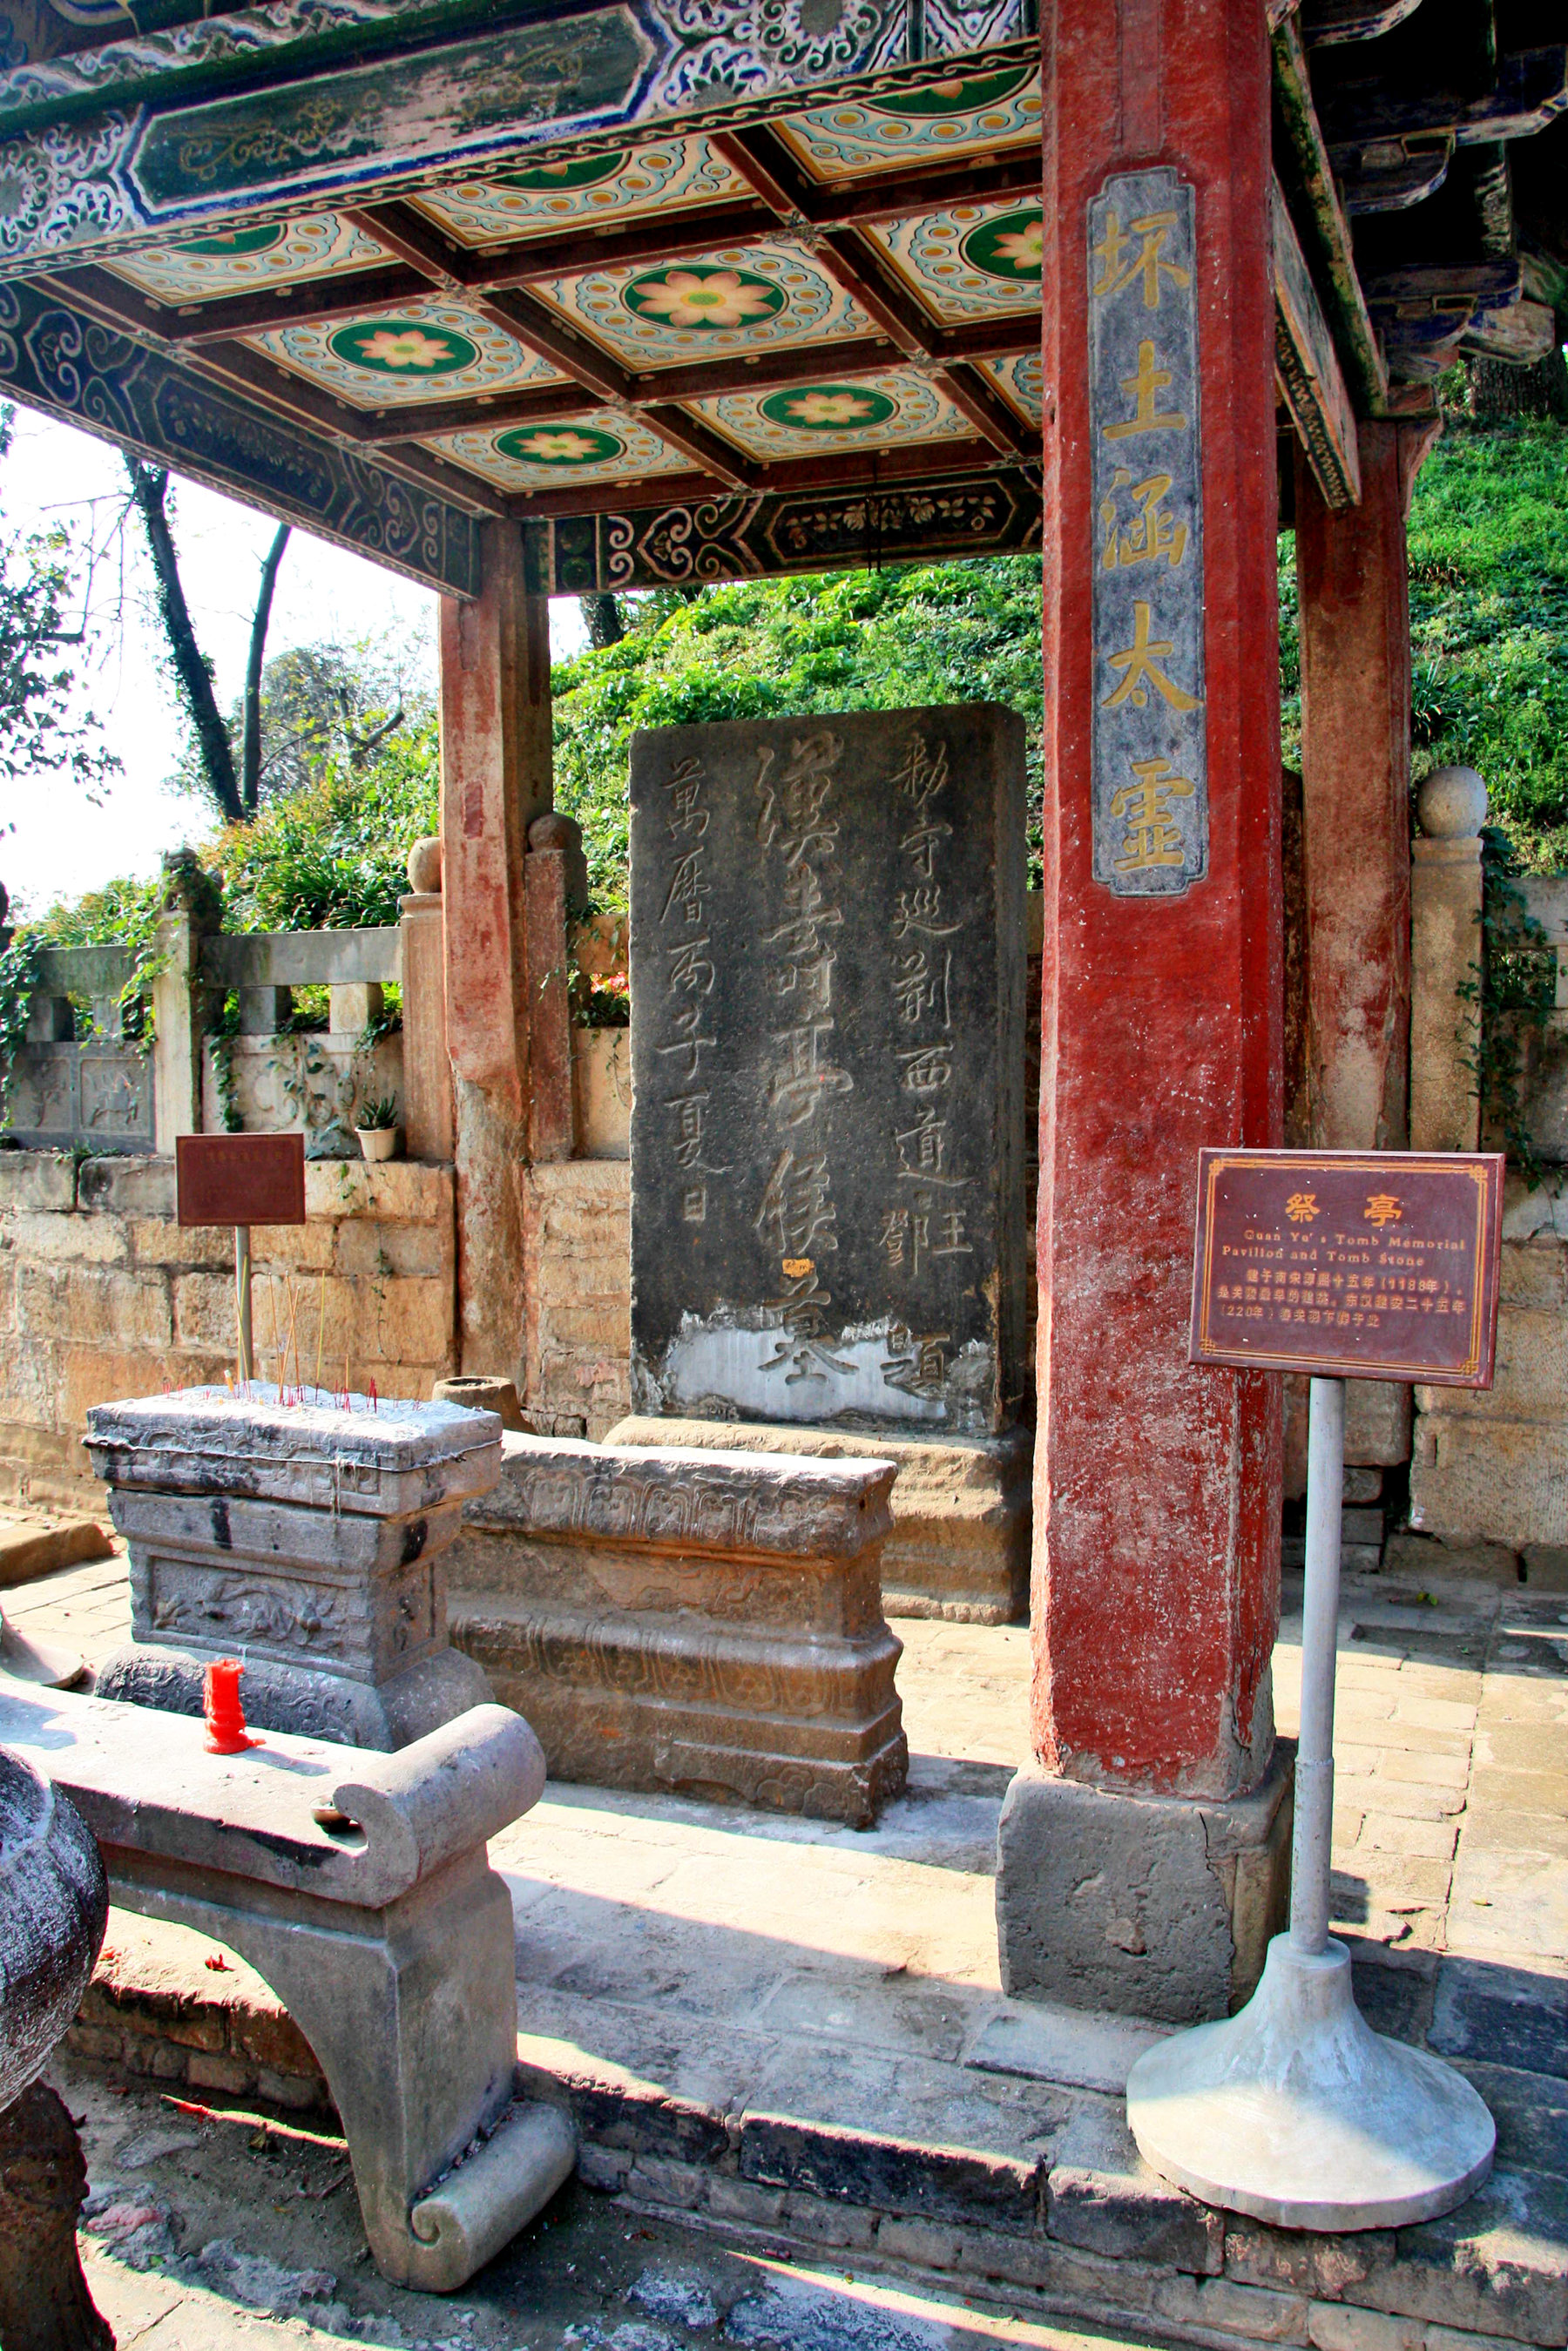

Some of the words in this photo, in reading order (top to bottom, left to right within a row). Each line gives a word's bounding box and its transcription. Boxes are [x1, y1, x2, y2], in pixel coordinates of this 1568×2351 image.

[1243, 1229, 1281, 1241] Guan
[1335, 1233, 1379, 1246] Tomb
[1388, 1236, 1466, 1251] Memorial
[1221, 1245, 1283, 1260] Pavilion
[1290, 1248, 1317, 1260] and
[1327, 1250, 1370, 1263] Tomb
[1379, 1252, 1425, 1266] Stone
